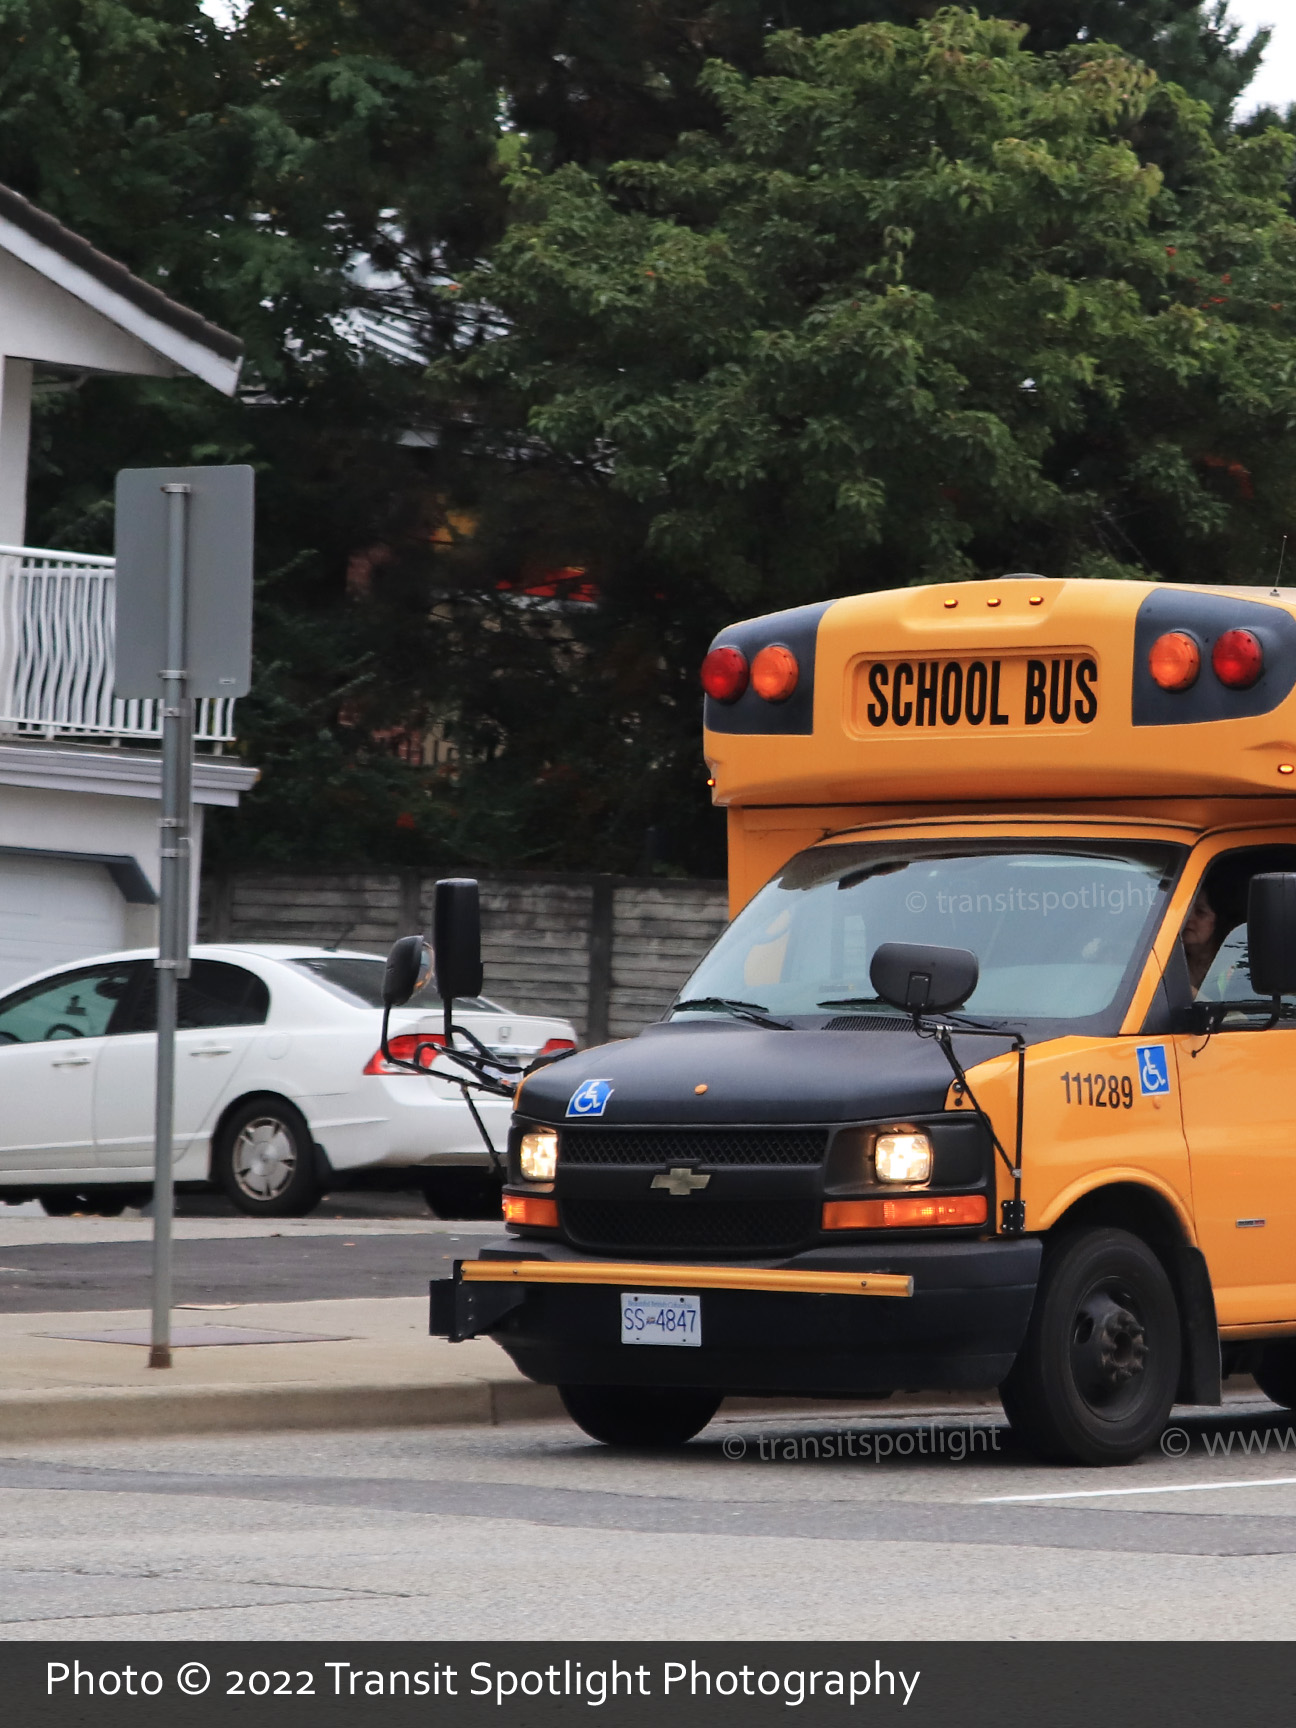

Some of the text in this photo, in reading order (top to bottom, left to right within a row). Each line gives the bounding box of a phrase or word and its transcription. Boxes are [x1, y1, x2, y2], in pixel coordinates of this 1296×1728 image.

[867, 659, 1098, 727] SCHOOL BUS
[1060, 1071, 1134, 1110] 111289
